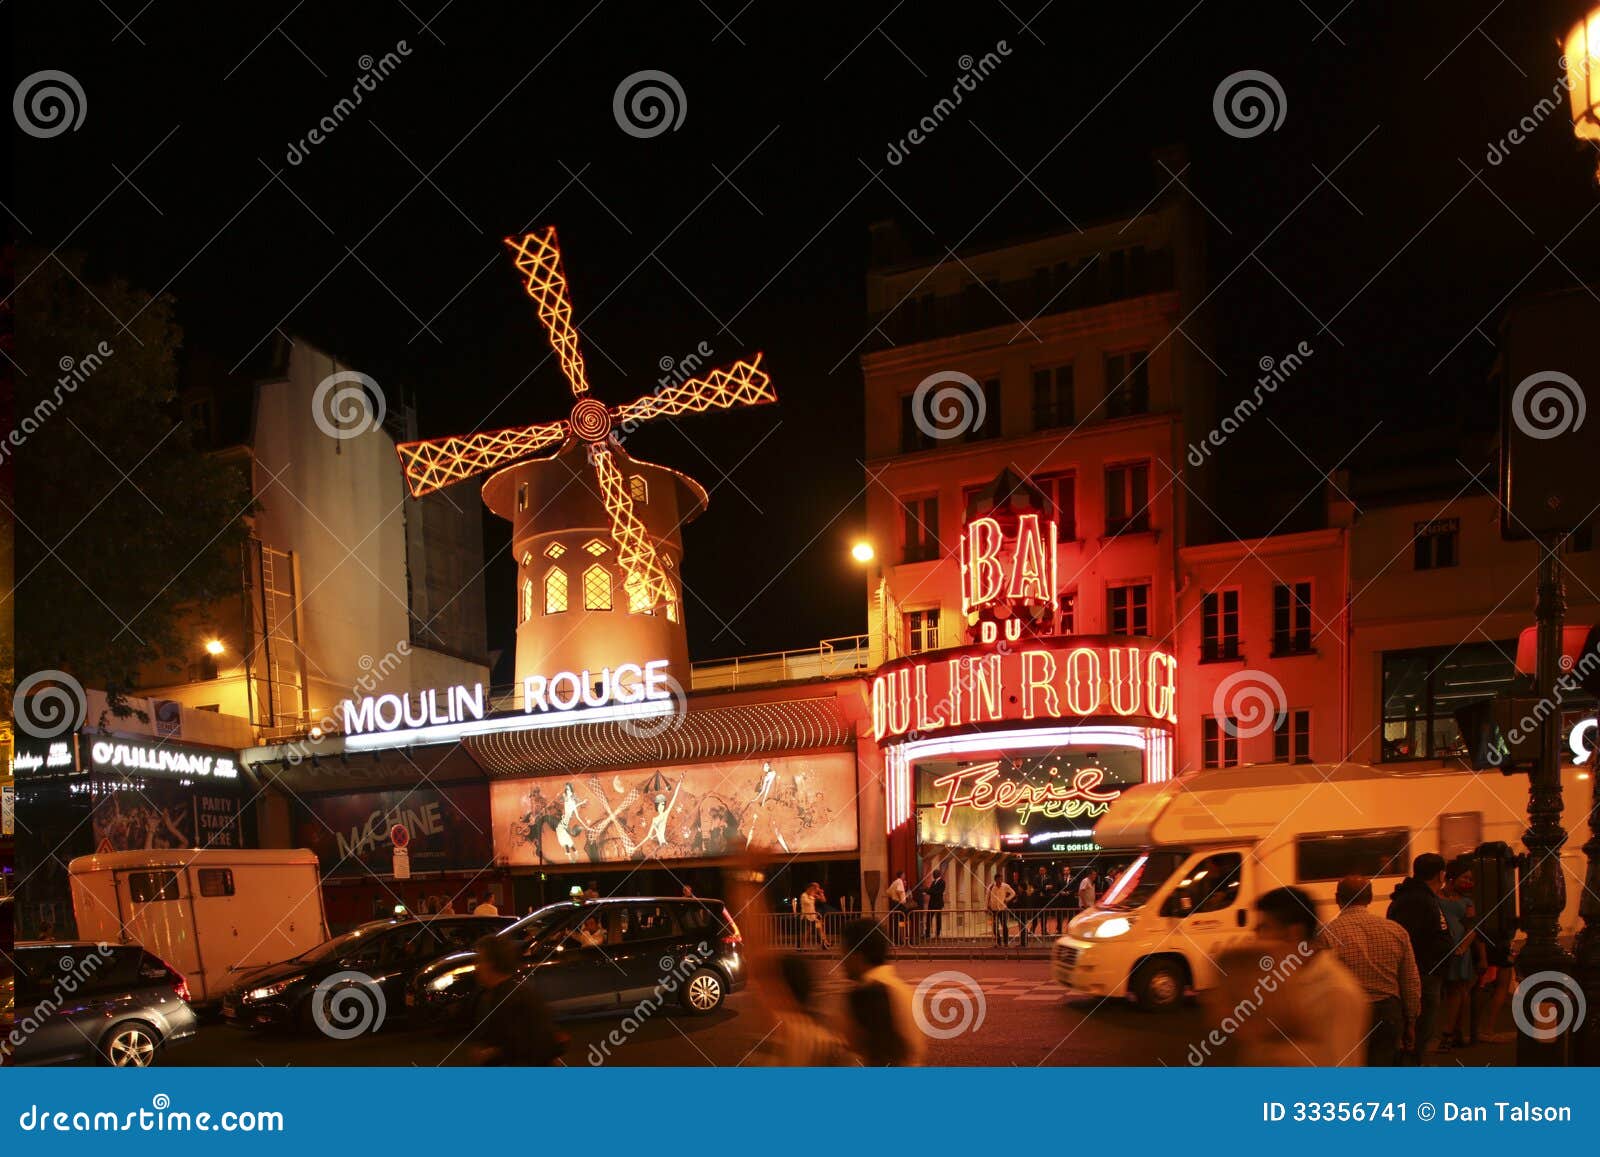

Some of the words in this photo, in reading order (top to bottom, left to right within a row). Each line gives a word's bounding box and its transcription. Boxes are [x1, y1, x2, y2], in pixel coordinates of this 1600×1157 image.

[981, 618, 1021, 644] DU
[343, 682, 484, 735] MOULIN
[523, 659, 671, 714] ROUGE
[872, 654, 1003, 744] OULIN
[92, 741, 213, 776] O'SULLIVANS
[202, 796, 232, 812] PARTY
[207, 832, 232, 847] HERE
